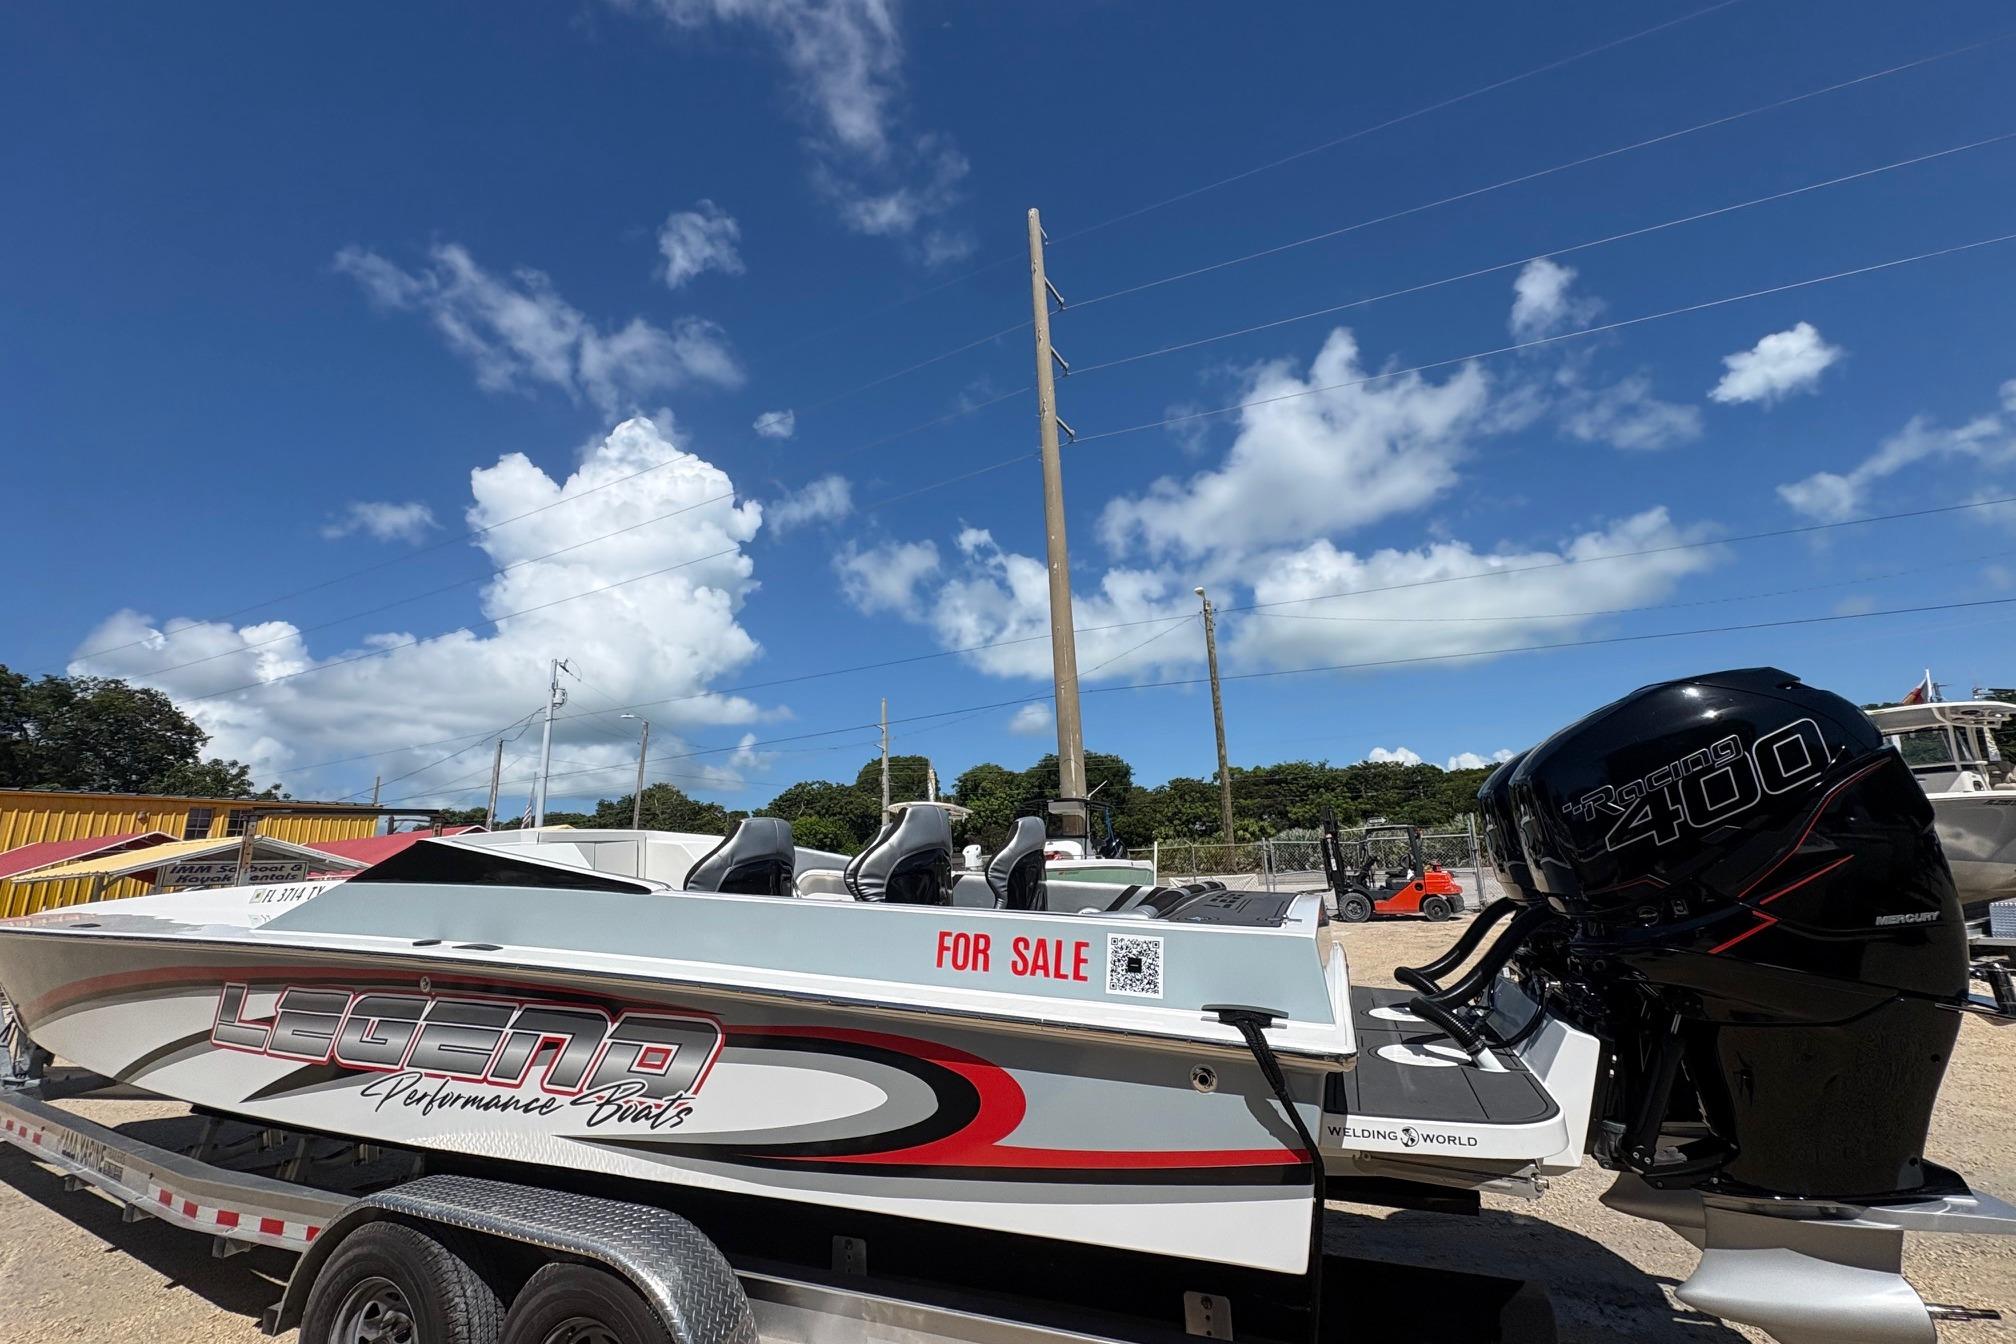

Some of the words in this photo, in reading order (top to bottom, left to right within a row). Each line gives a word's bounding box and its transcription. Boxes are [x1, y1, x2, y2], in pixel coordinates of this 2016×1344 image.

[1579, 734, 1744, 821] Racing
[1605, 718, 1831, 851] 400
[175, 874, 232, 885] Kayak
[249, 873, 298, 882] entals
[217, 864, 285, 873] Saboat
[290, 864, 304, 873] &
[261, 889, 273, 903] FL
[1875, 910, 1940, 926] MERCURY
[936, 930, 992, 973] FOR
[1010, 935, 1090, 982] SALE
[211, 981, 726, 1104] LEGEND
[360, 1071, 564, 1117] Performance
[570, 1080, 696, 1129] Boats
[1327, 1125, 1398, 1141] WELDING
[1420, 1132, 1478, 1147] WORLD
